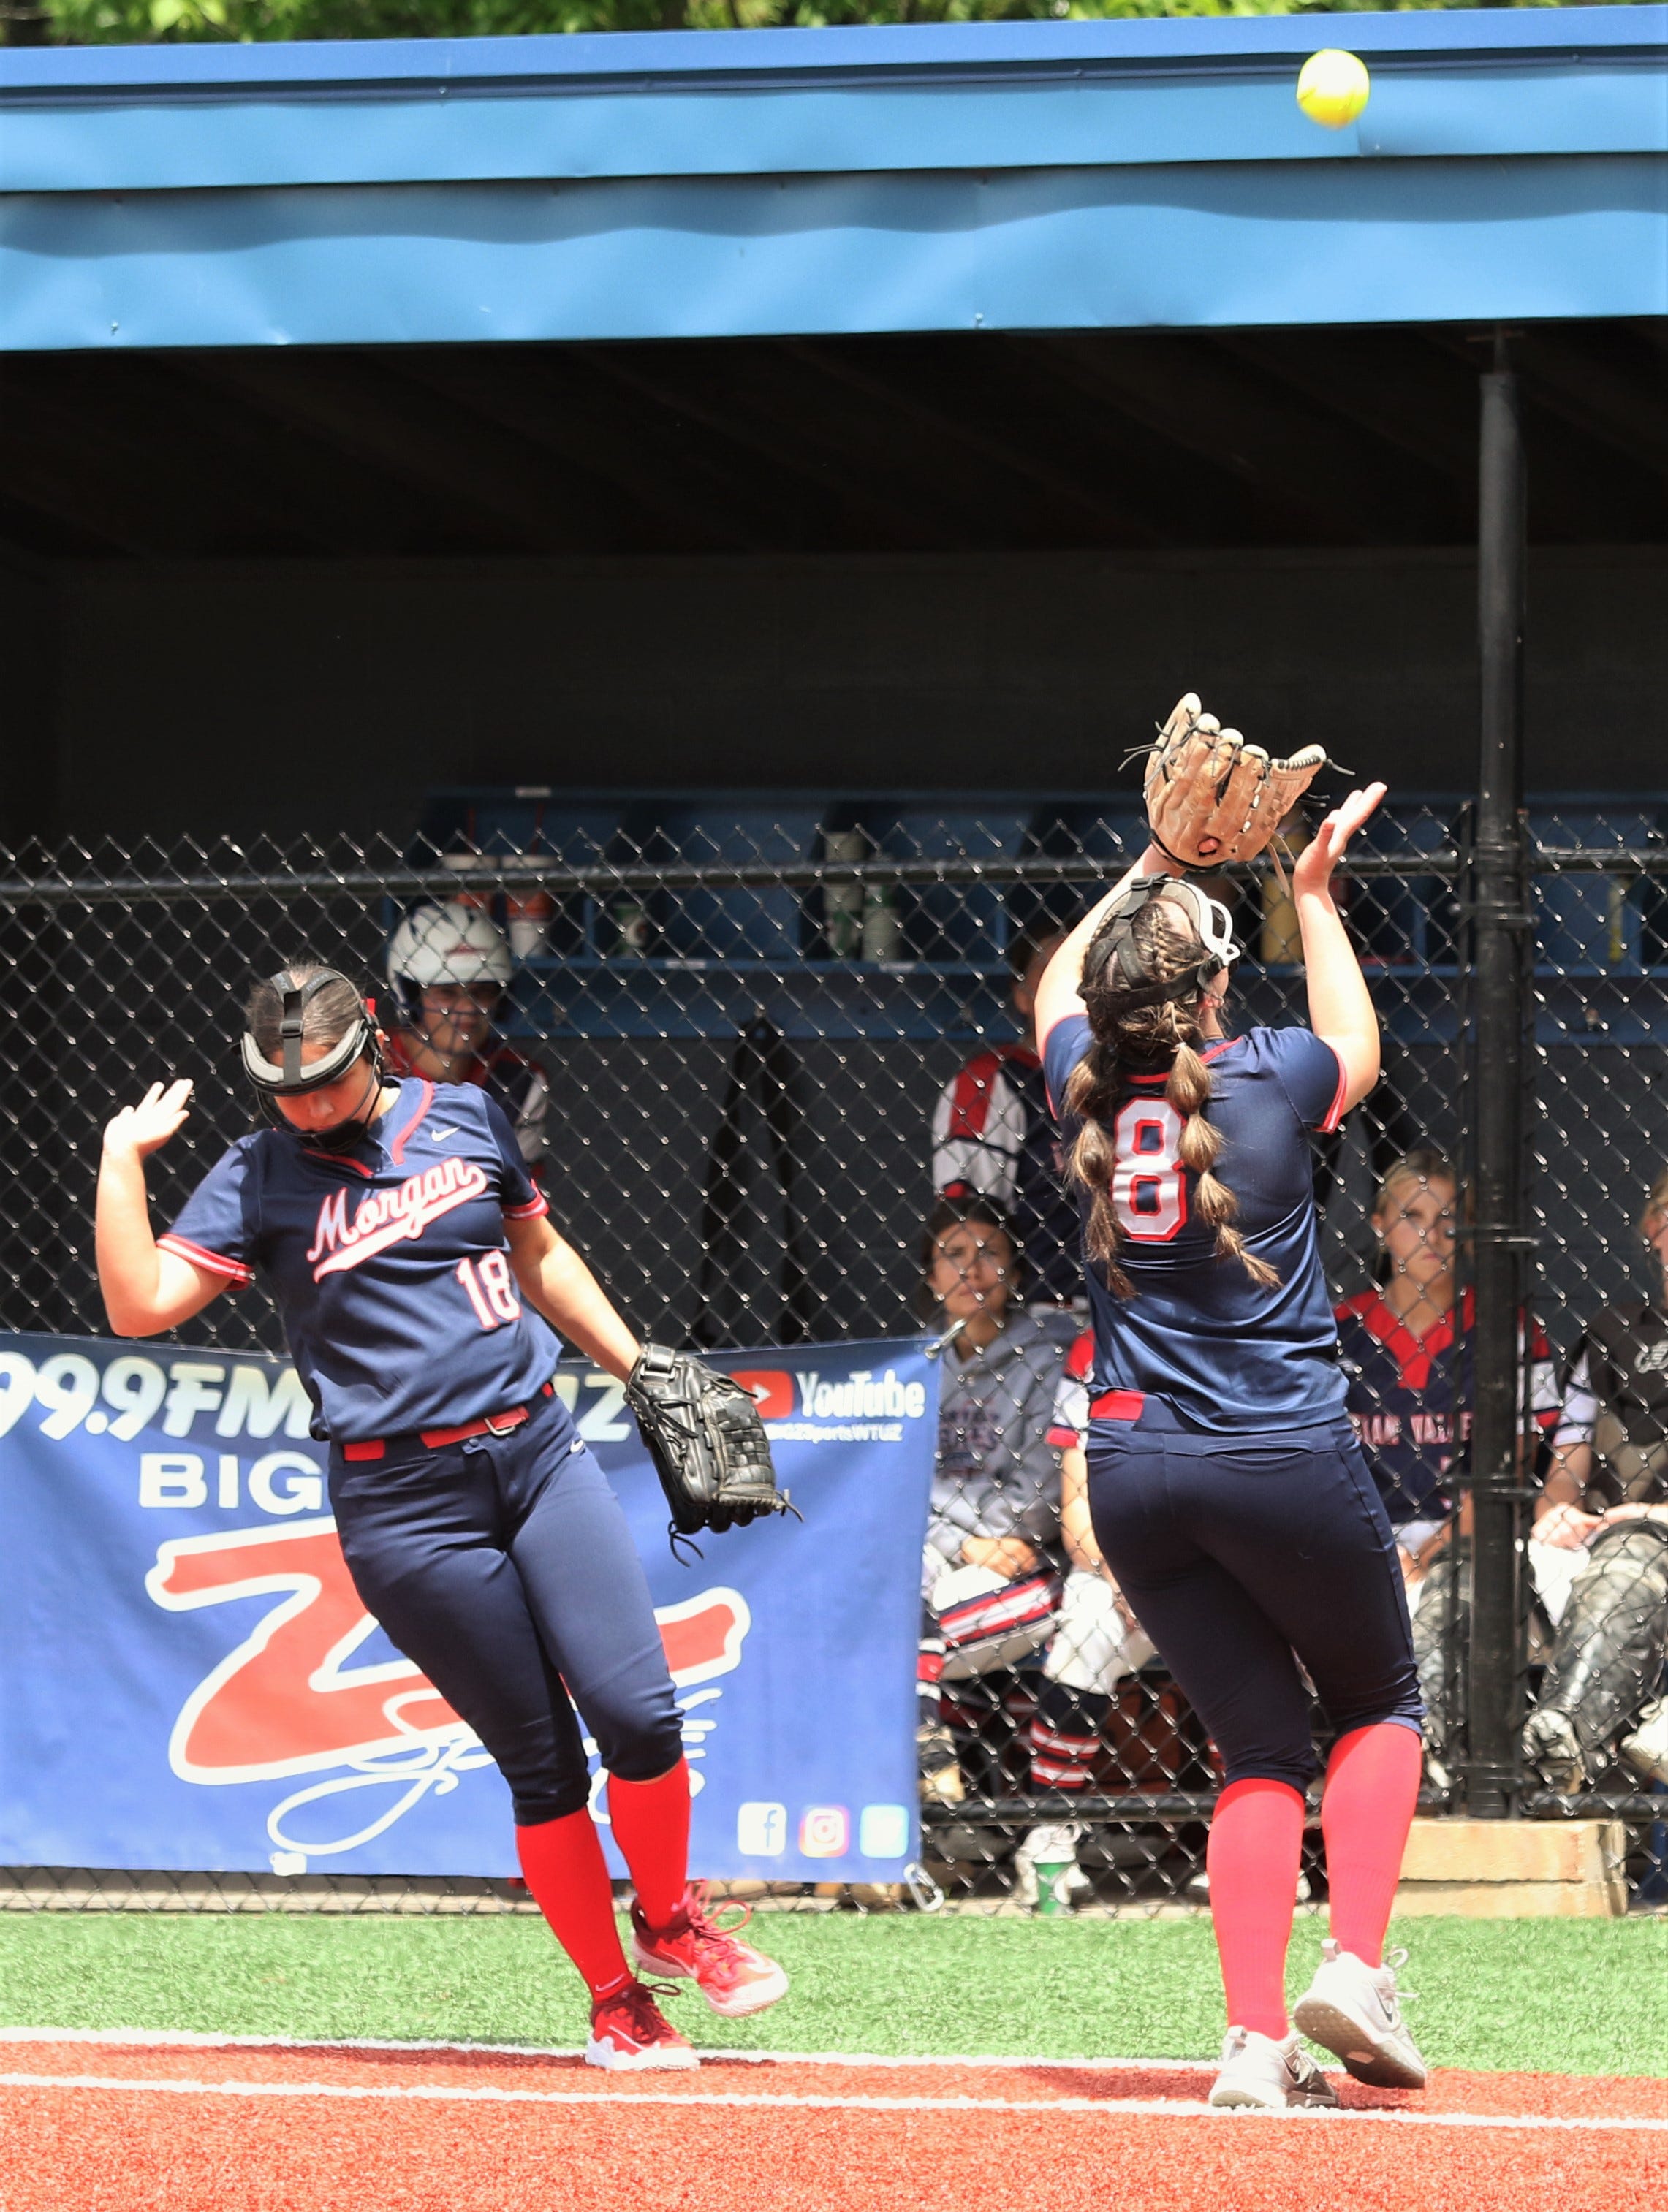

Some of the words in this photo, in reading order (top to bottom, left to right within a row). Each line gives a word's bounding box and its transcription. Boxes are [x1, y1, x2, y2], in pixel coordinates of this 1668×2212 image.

[1110, 1095, 1187, 1241] 8
[306, 1156, 488, 1284] Morgan
[456, 1249, 522, 1329] 18
[796, 1369, 925, 1418] YouTube
[139, 1451, 322, 1515] BIG
